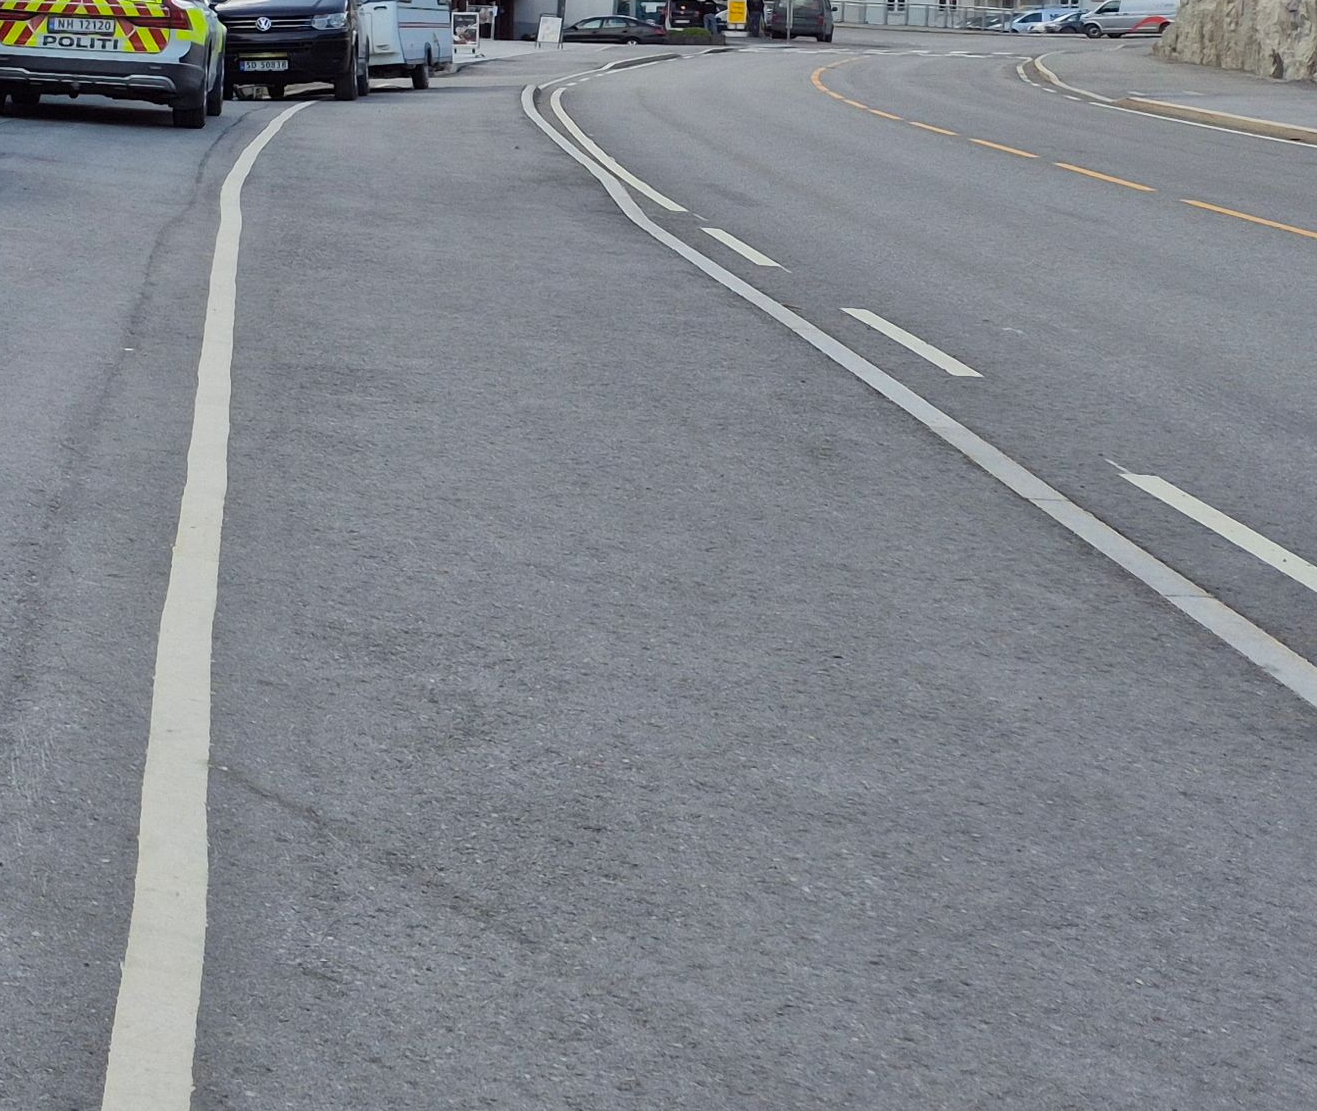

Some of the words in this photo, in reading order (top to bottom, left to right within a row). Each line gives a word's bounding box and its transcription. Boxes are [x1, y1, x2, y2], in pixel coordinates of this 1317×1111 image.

[57, 17, 75, 30] NH
[78, 18, 111, 31] 12120
[42, 35, 119, 50] POLITI
